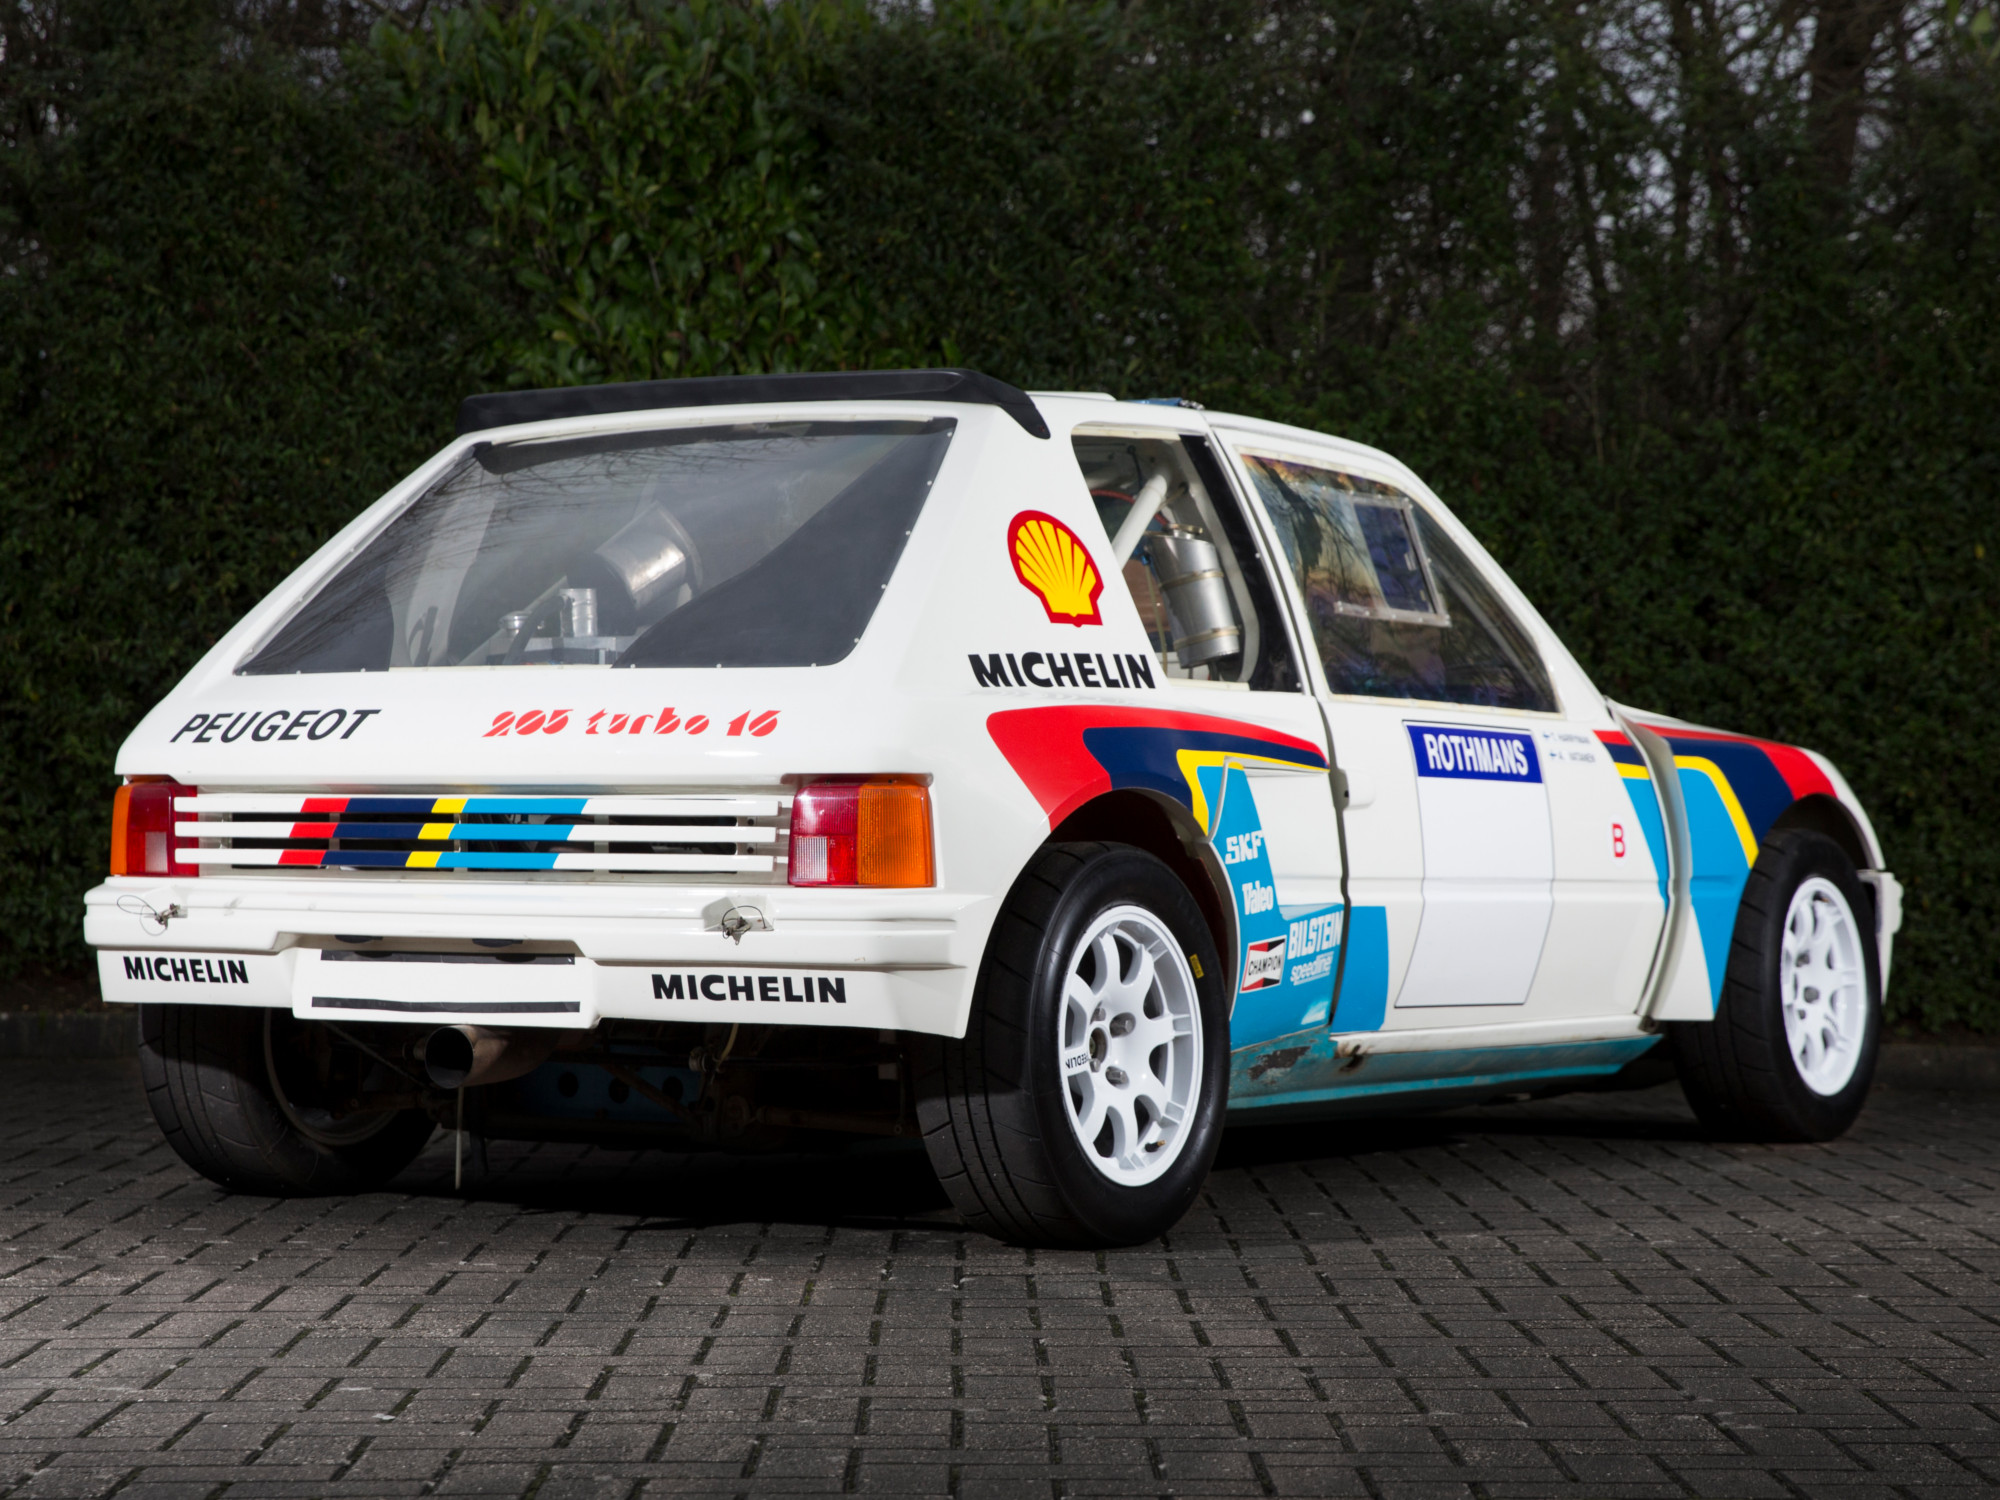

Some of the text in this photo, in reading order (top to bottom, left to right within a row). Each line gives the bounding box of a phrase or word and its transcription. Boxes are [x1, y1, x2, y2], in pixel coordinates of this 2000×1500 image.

[967, 651, 1157, 689] MICHELIN
[169, 708, 382, 744] PEUGEOT
[481, 706, 782, 738] 205 turbo 16
[1422, 733, 1530, 777] ROTHMANS
[1224, 830, 1264, 865] SKF
[1611, 823, 1626, 858] B
[1241, 880, 1274, 916] Valeo
[1286, 910, 1344, 960] BILSTEIN
[122, 956, 250, 985] MICHELIN
[1247, 954, 1283, 977] CHAMPION
[1290, 951, 1335, 986] speedline
[651, 973, 848, 1005] MICHELIN
